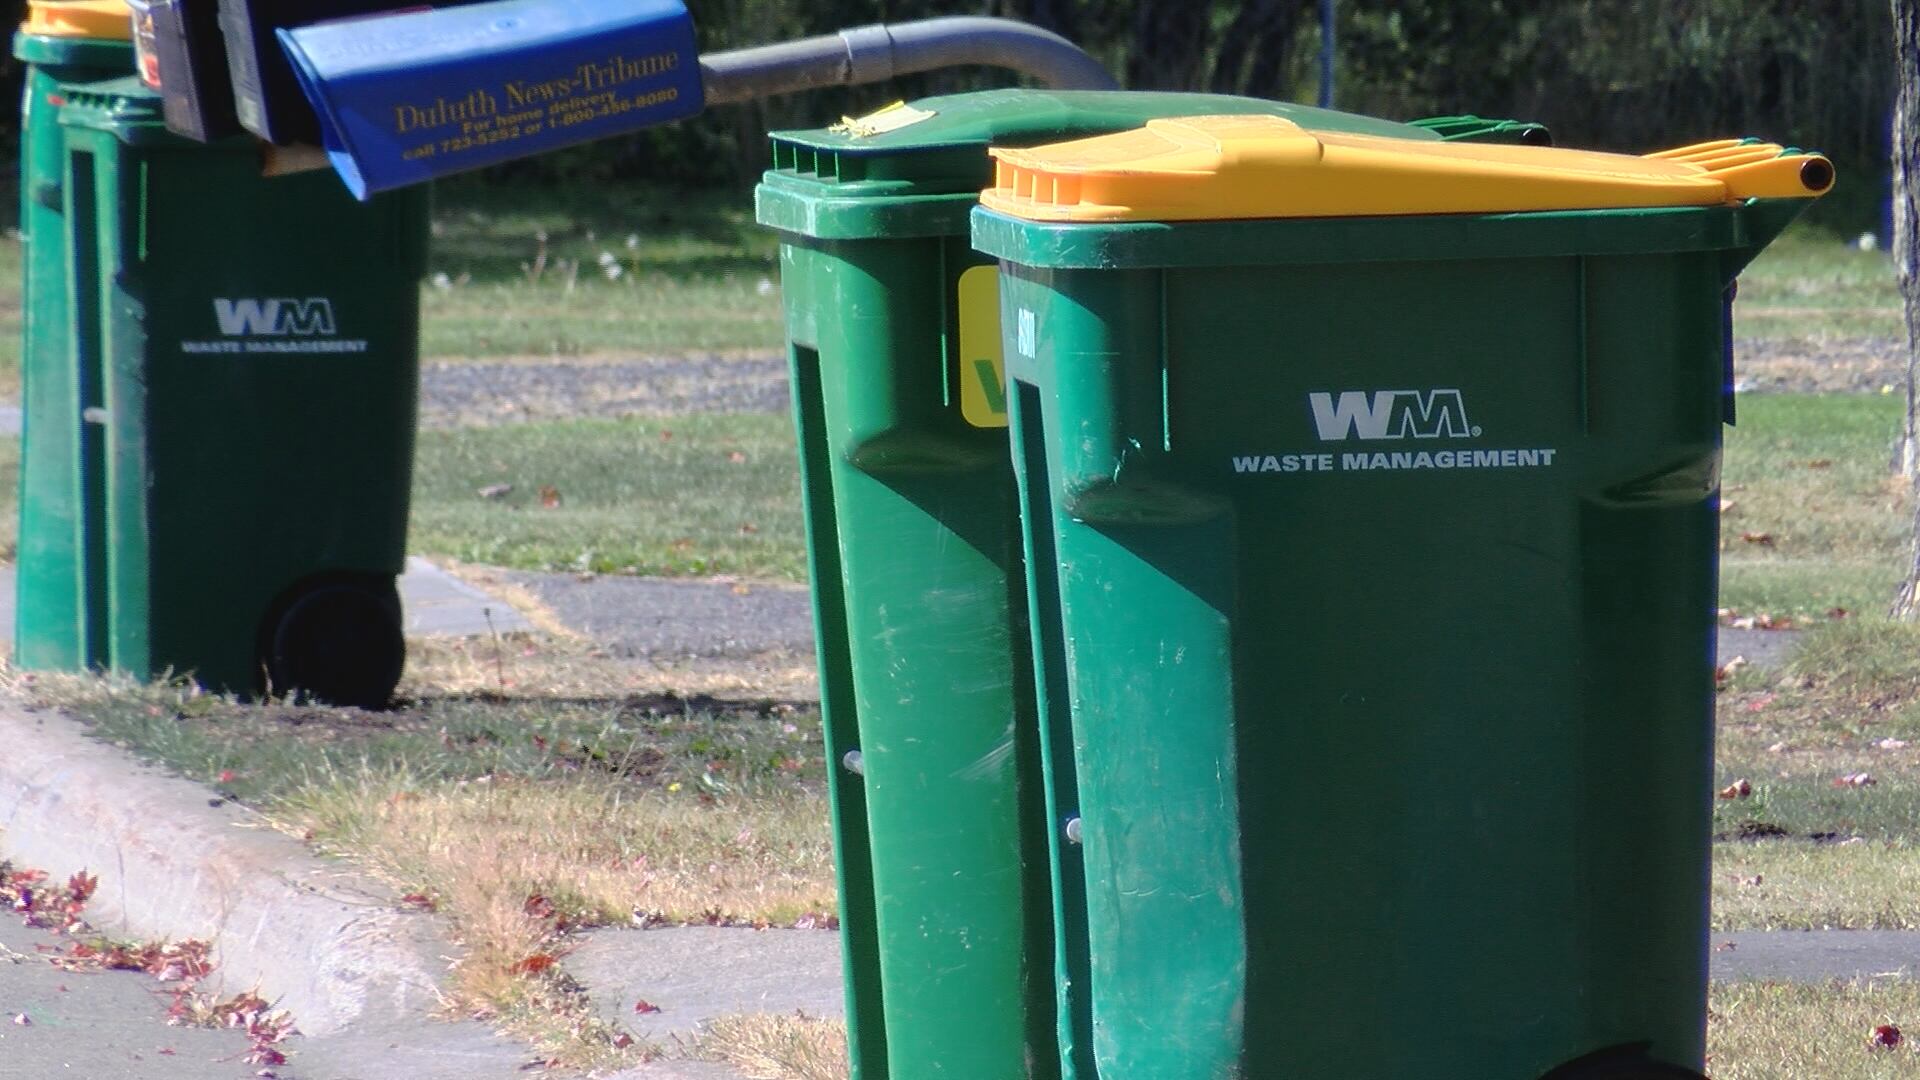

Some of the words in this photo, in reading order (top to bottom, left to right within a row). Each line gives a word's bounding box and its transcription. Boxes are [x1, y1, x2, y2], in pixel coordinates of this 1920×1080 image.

[394, 88, 497, 133] Duluth
[505, 51, 679, 110] News-Tribune
[463, 120, 491, 134] For
[495, 108, 543, 127] home
[549, 90, 617, 115] delivery
[402, 142, 434, 160] call
[524, 122, 543, 135] or
[181, 340, 241, 353] WASTE
[245, 340, 368, 353] MANAGEMENT
[1232, 454, 1333, 473] WASTE
[1341, 449, 1556, 471] MANAGEMENT
